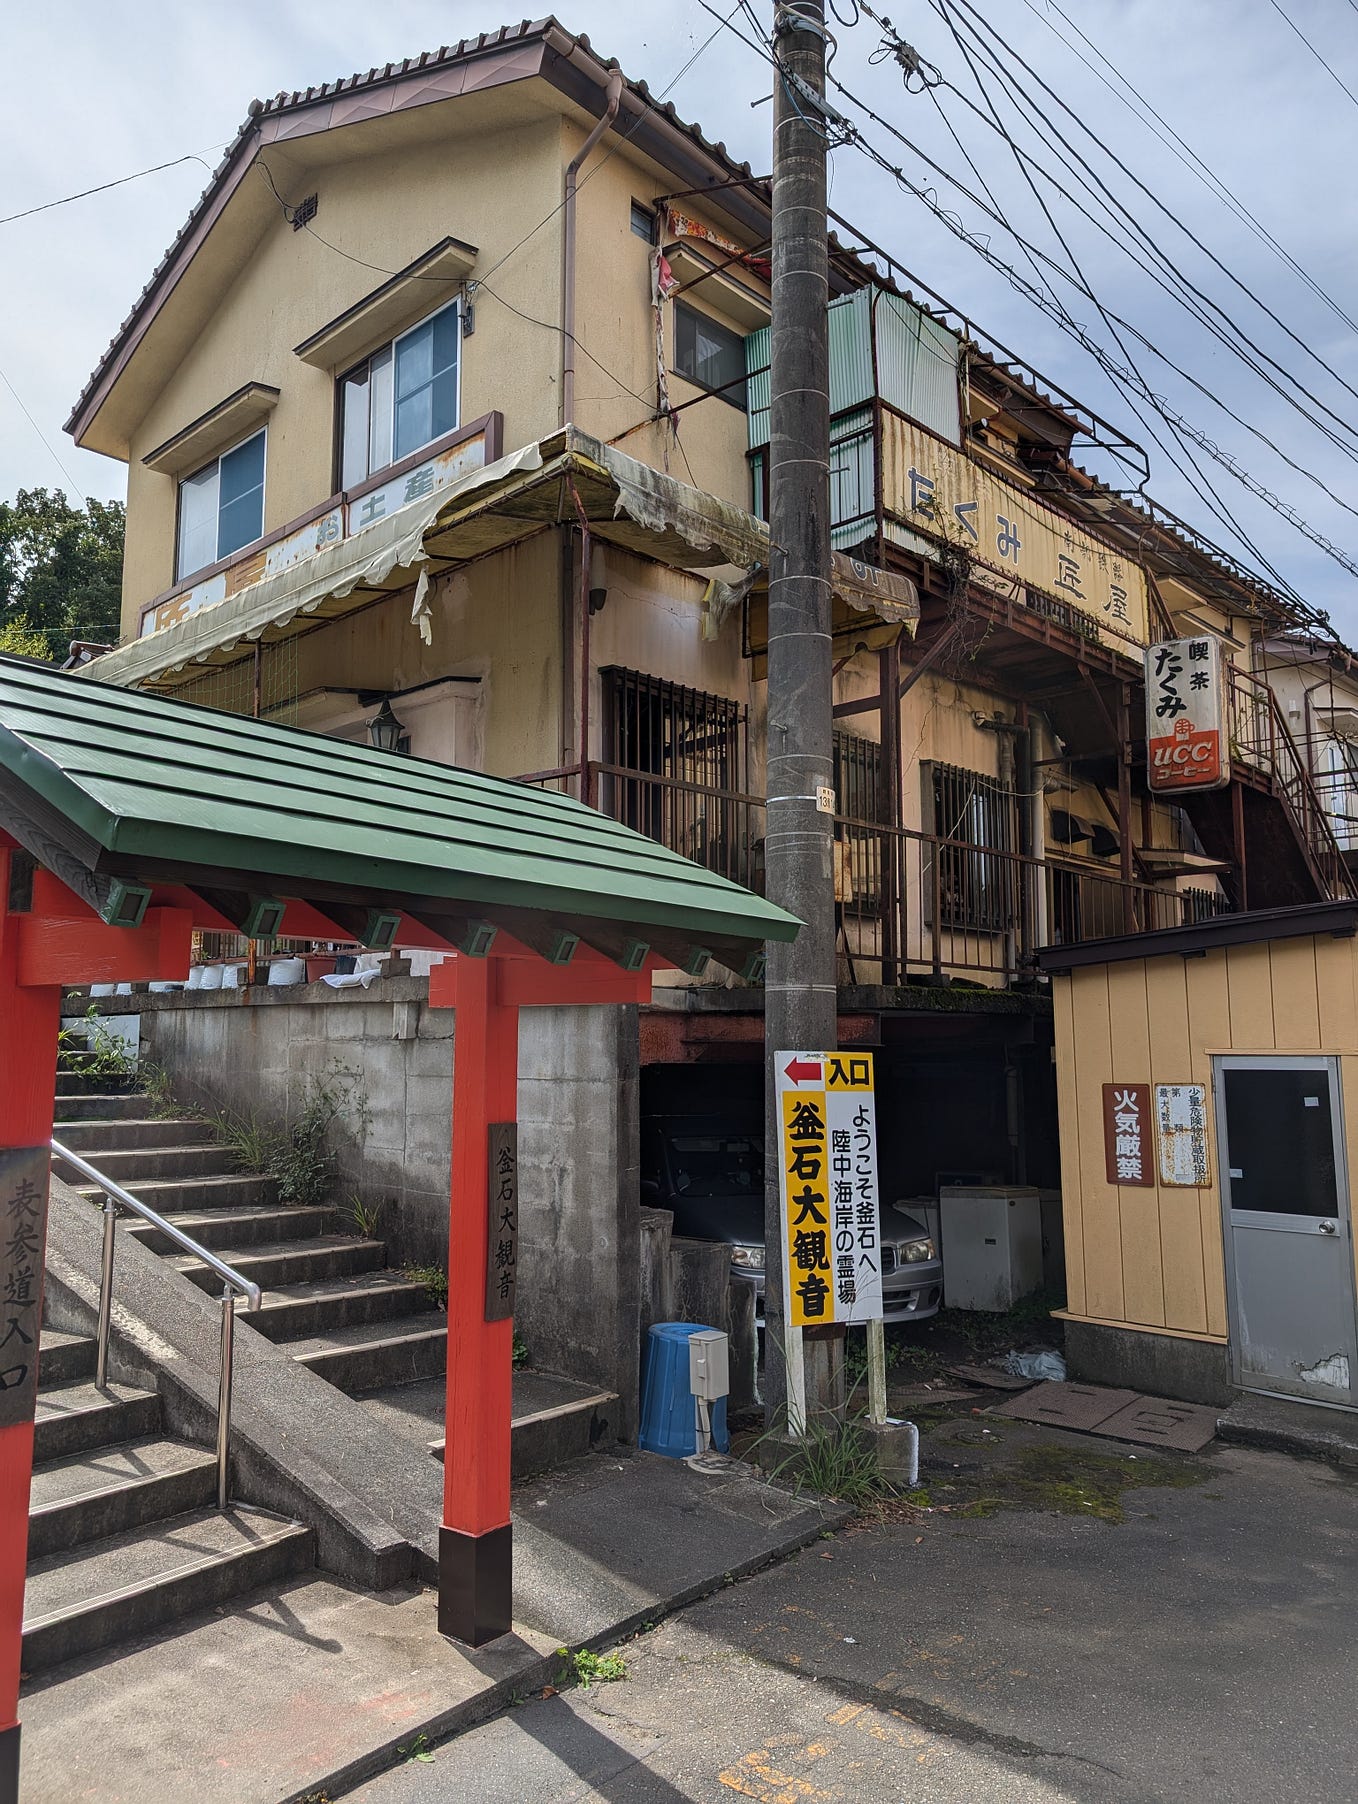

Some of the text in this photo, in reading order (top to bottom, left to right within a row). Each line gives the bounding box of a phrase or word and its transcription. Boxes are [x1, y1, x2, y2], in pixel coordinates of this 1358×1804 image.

[316, 466, 435, 546] お土産
[907, 466, 1022, 566] たくみ
[1054, 553, 1133, 627] 匠屋
[1154, 648, 1188, 719] たくみ
[1189, 640, 1210, 691] 喫茶
[1156, 767, 1210, 780] コーヒー
[828, 1058, 870, 1086] 入口
[1113, 1089, 1143, 1180] 火気厳禁
[786, 1101, 831, 1318] 釜石大観音
[831, 1129, 857, 1305] 陸中海岸の霊場
[852, 1104, 878, 1273] ようこそ釜石へ
[0, 1178, 41, 1391] 表参道入口
